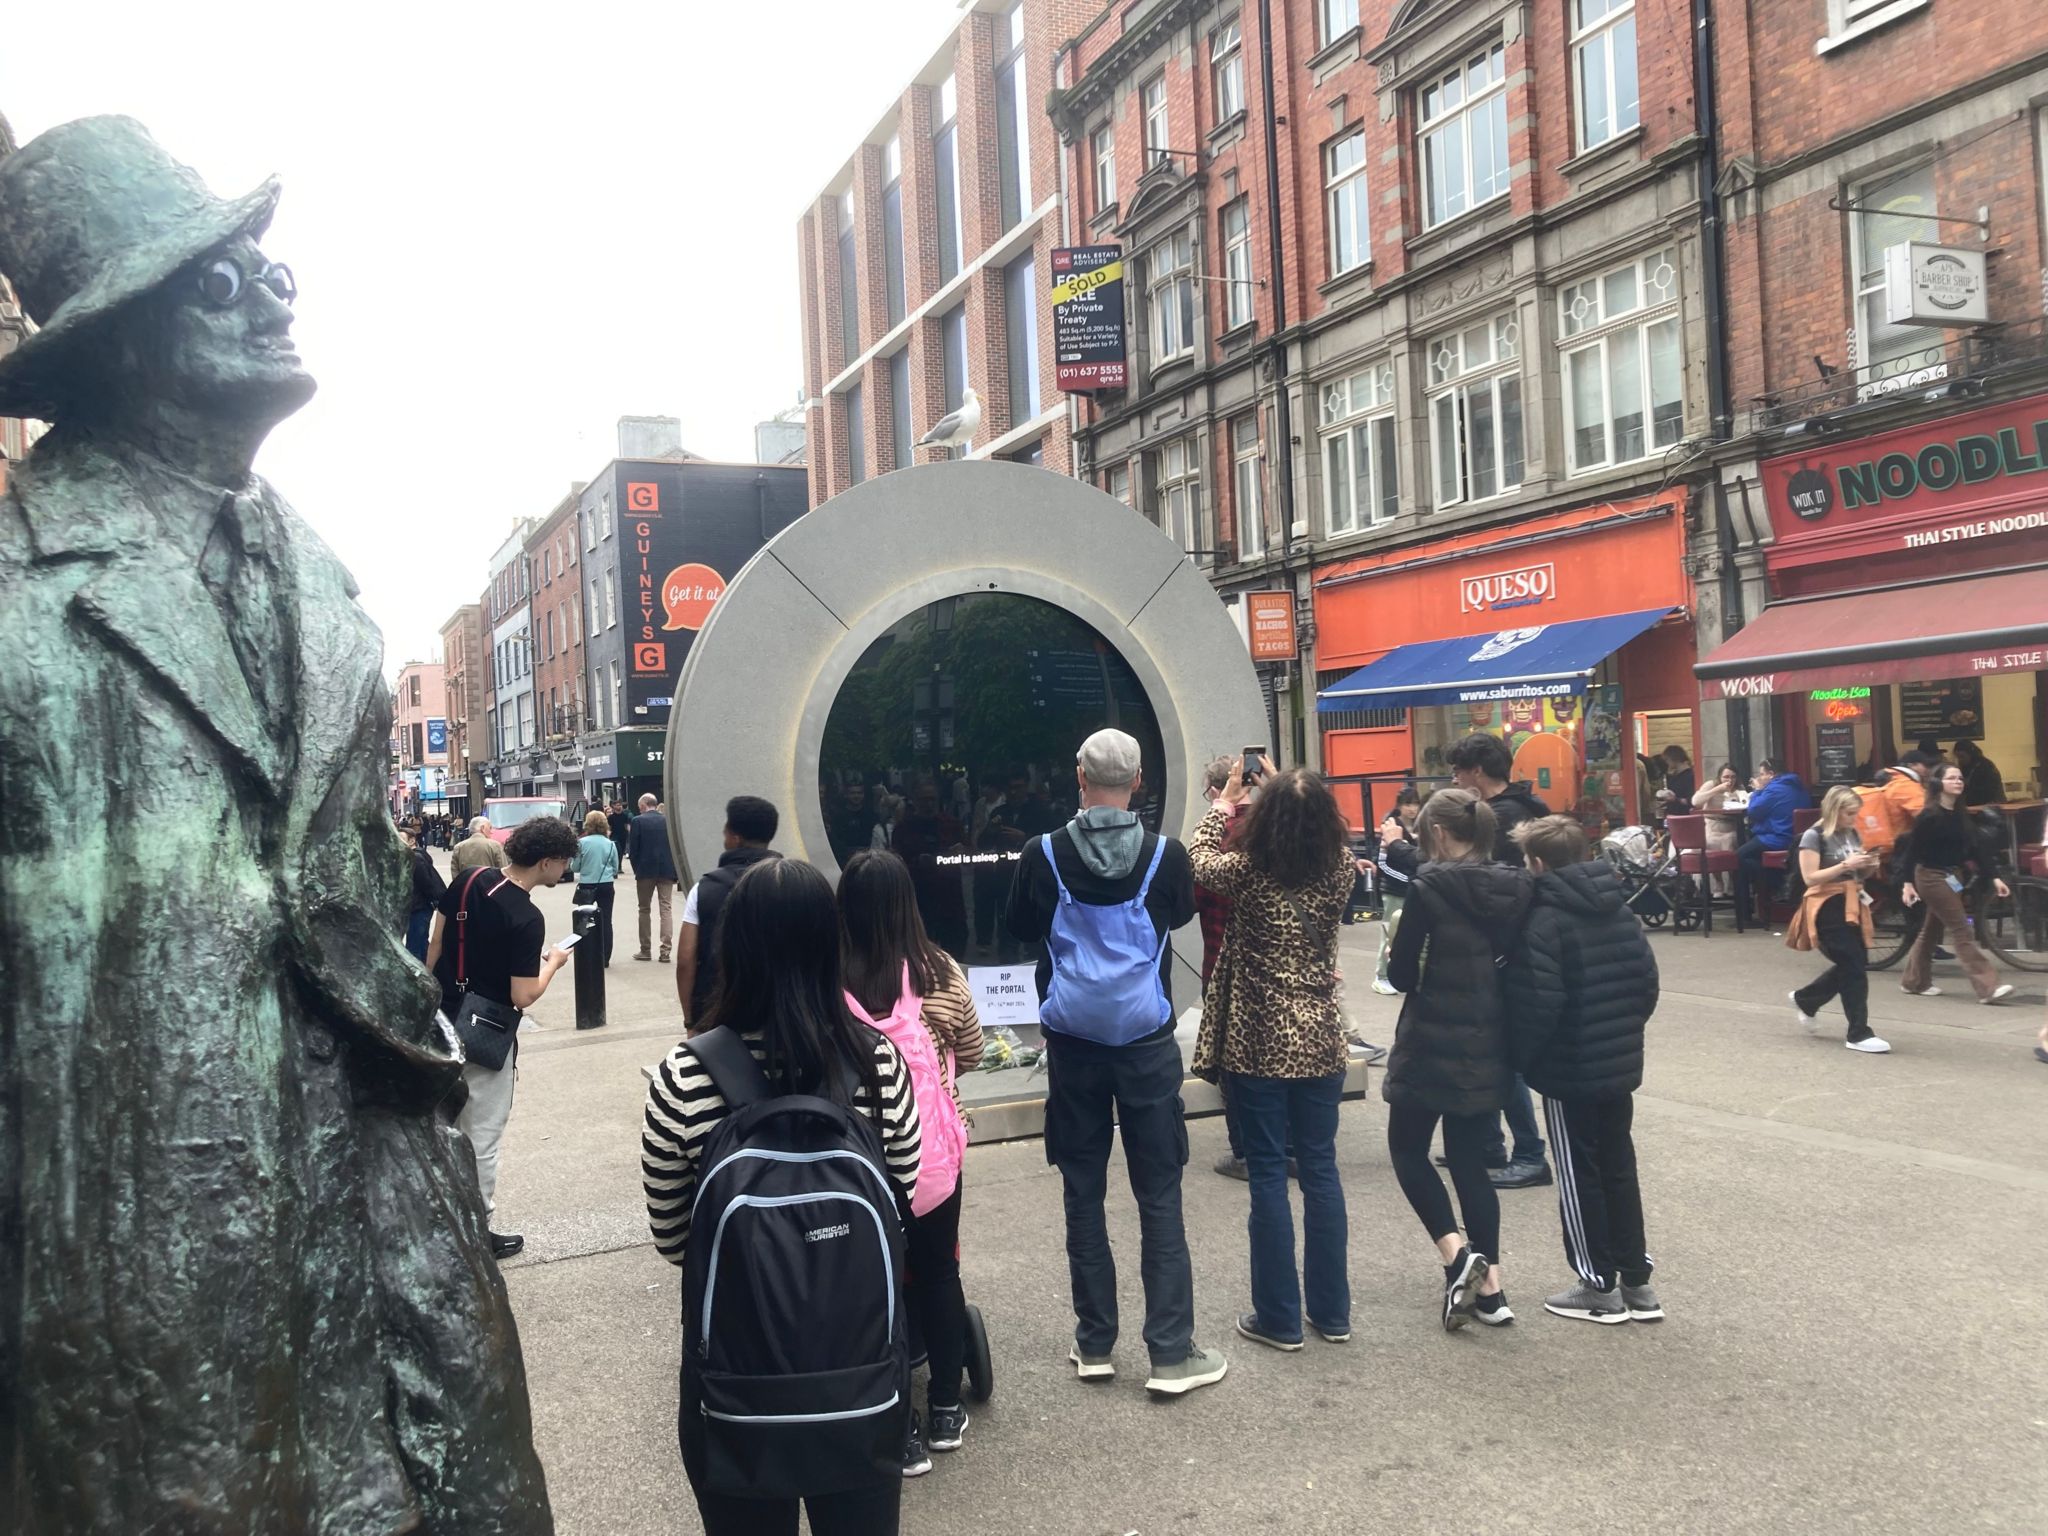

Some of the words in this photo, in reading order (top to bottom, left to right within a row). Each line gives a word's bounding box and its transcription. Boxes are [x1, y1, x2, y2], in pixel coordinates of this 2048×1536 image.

[1055, 257, 1070, 265] QRE
[1073, 258, 1107, 266] ADVISERS
[1093, 251, 1119, 259] ESTATE
[1068, 271, 1106, 295] SOLD
[1921, 271, 1951, 286] BARBER
[1953, 275, 1971, 287] SHOP
[1058, 305, 1069, 316] By
[1072, 303, 1104, 313] Private
[1058, 315, 1087, 325] Treaty
[1060, 367, 1078, 379] (01)
[1080, 366, 1097, 377] 637
[1100, 365, 1123, 375] 5555
[1099, 374, 1123, 384] qre.ie
[633, 486, 653, 507] G
[1792, 491, 1815, 508] WOK
[1903, 530, 1939, 548] THAI
[1941, 522, 1986, 543] STYLE
[636, 521, 654, 640] GUINEYS
[670, 585, 691, 608] Get
[694, 585, 703, 601] it
[1466, 569, 1549, 612] QUESO
[1255, 620, 1289, 630] NACHOS
[1257, 641, 1290, 651] TACOS
[640, 646, 659, 668] G
[1971, 655, 1998, 671] THAI
[2003, 651, 2042, 667] STYLE
[1459, 684, 1571, 702] www.saburritos.com
[1810, 687, 1849, 700] Noodle
[1849, 686, 1871, 699] Bar
[1826, 700, 1858, 721] Open
[647, 751, 664, 761] ST
[936, 854, 962, 865] Portal
[963, 854, 971, 863] is
[972, 852, 999, 864] asleep
[1000, 973, 1011, 981] RIP
[986, 986, 999, 995] THE
[1000, 985, 1026, 994] PORTAL
[805, 1222, 849, 1238] AMERICAN
[805, 1228, 850, 1243] TOURISTER
